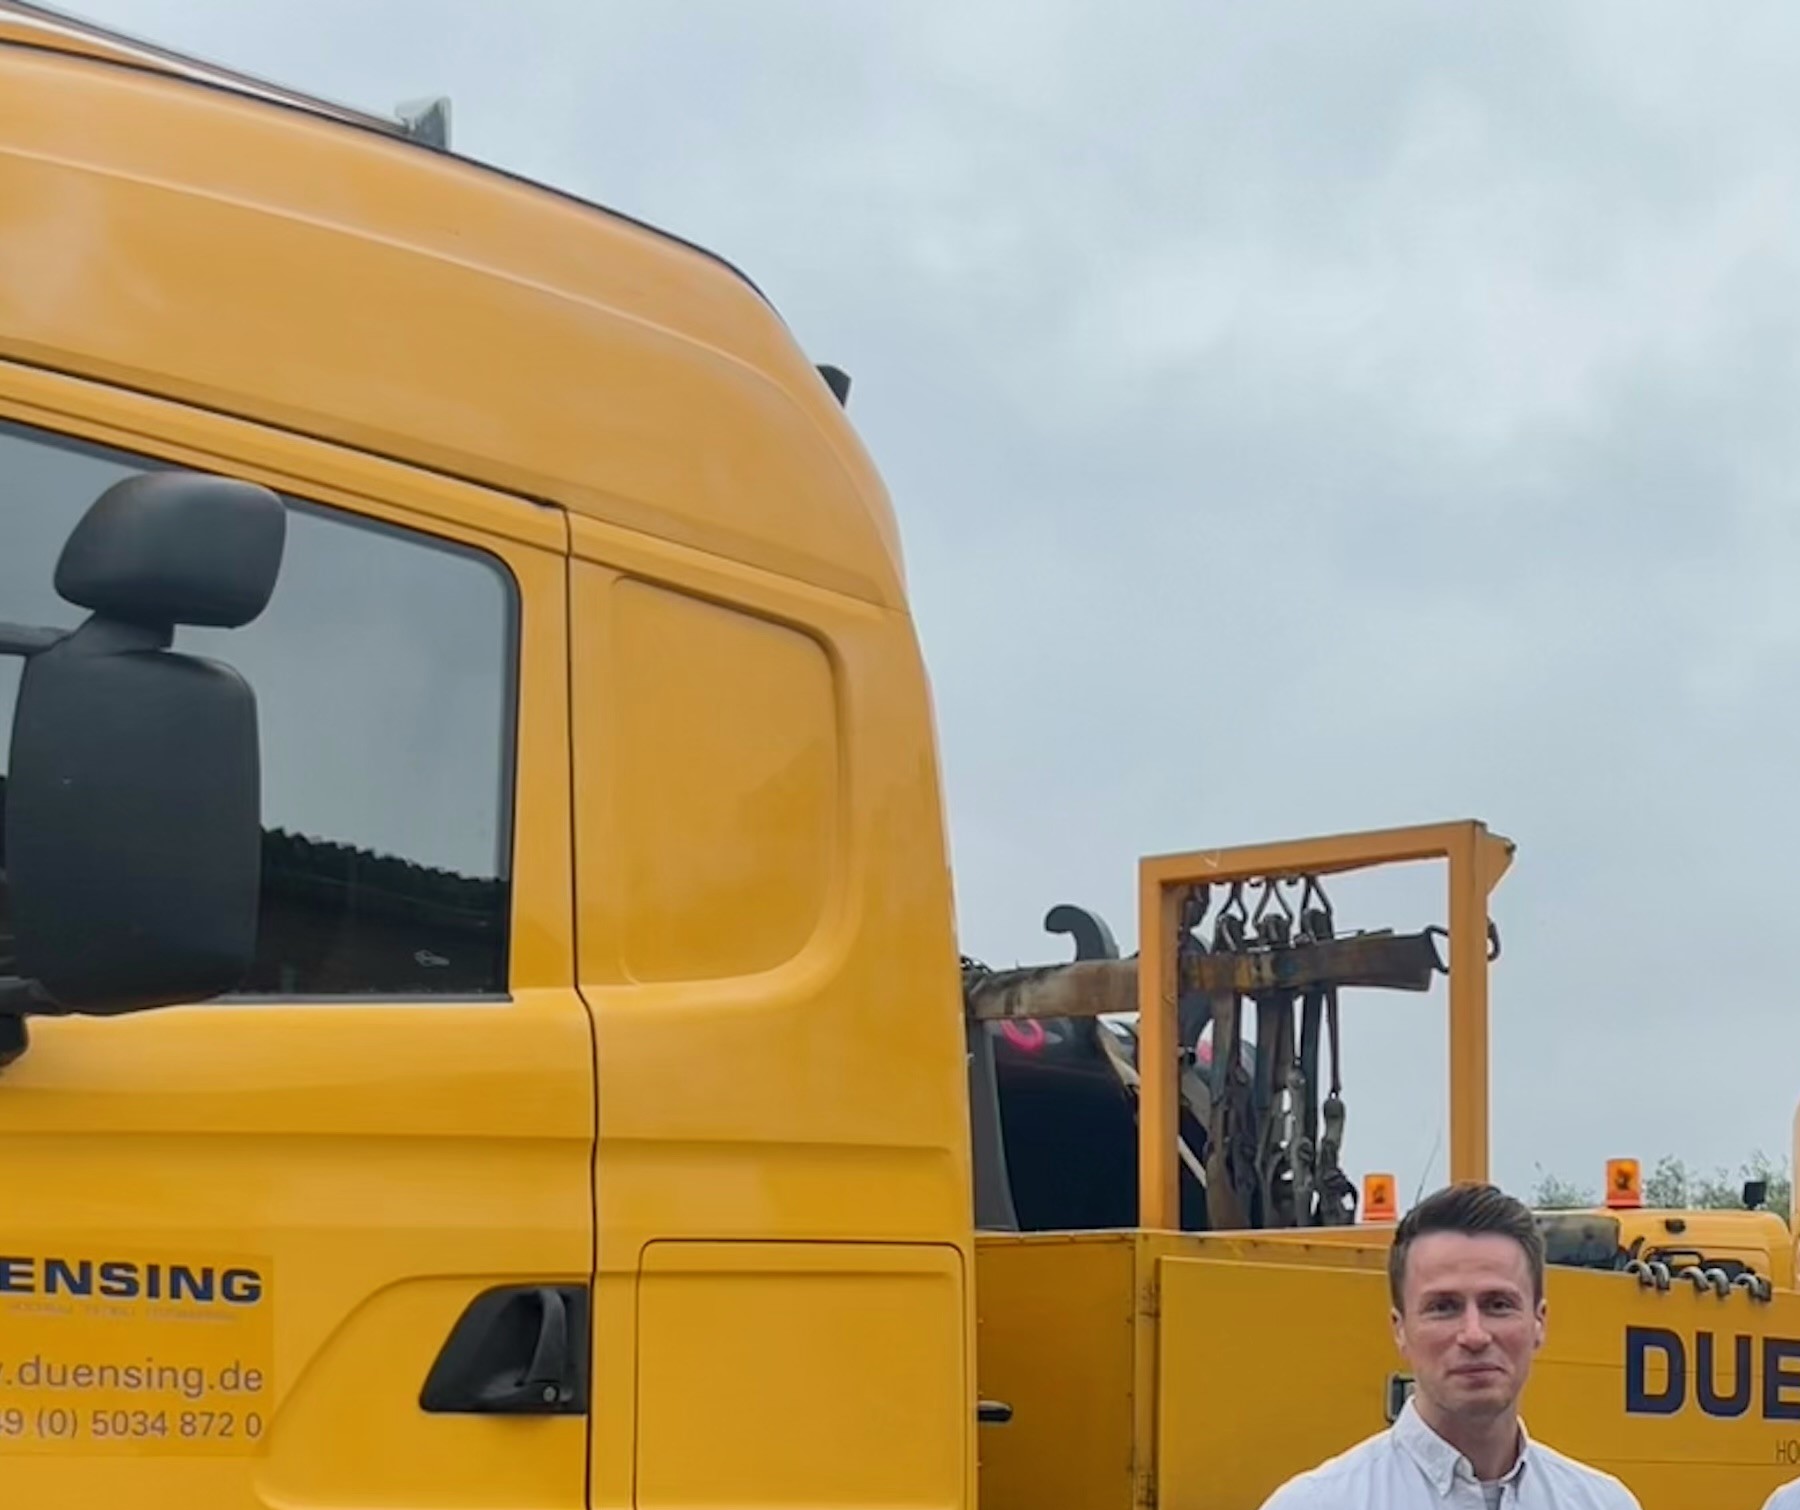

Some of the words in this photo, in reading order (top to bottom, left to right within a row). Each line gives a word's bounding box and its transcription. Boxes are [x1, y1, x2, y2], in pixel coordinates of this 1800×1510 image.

[0, 1354, 262, 1399] .duensing.de
[37, 1408, 78, 1438] (0)
[92, 1410, 168, 1437] 5034
[180, 1411, 234, 1437] 872
[245, 1412, 262, 1437] 0
